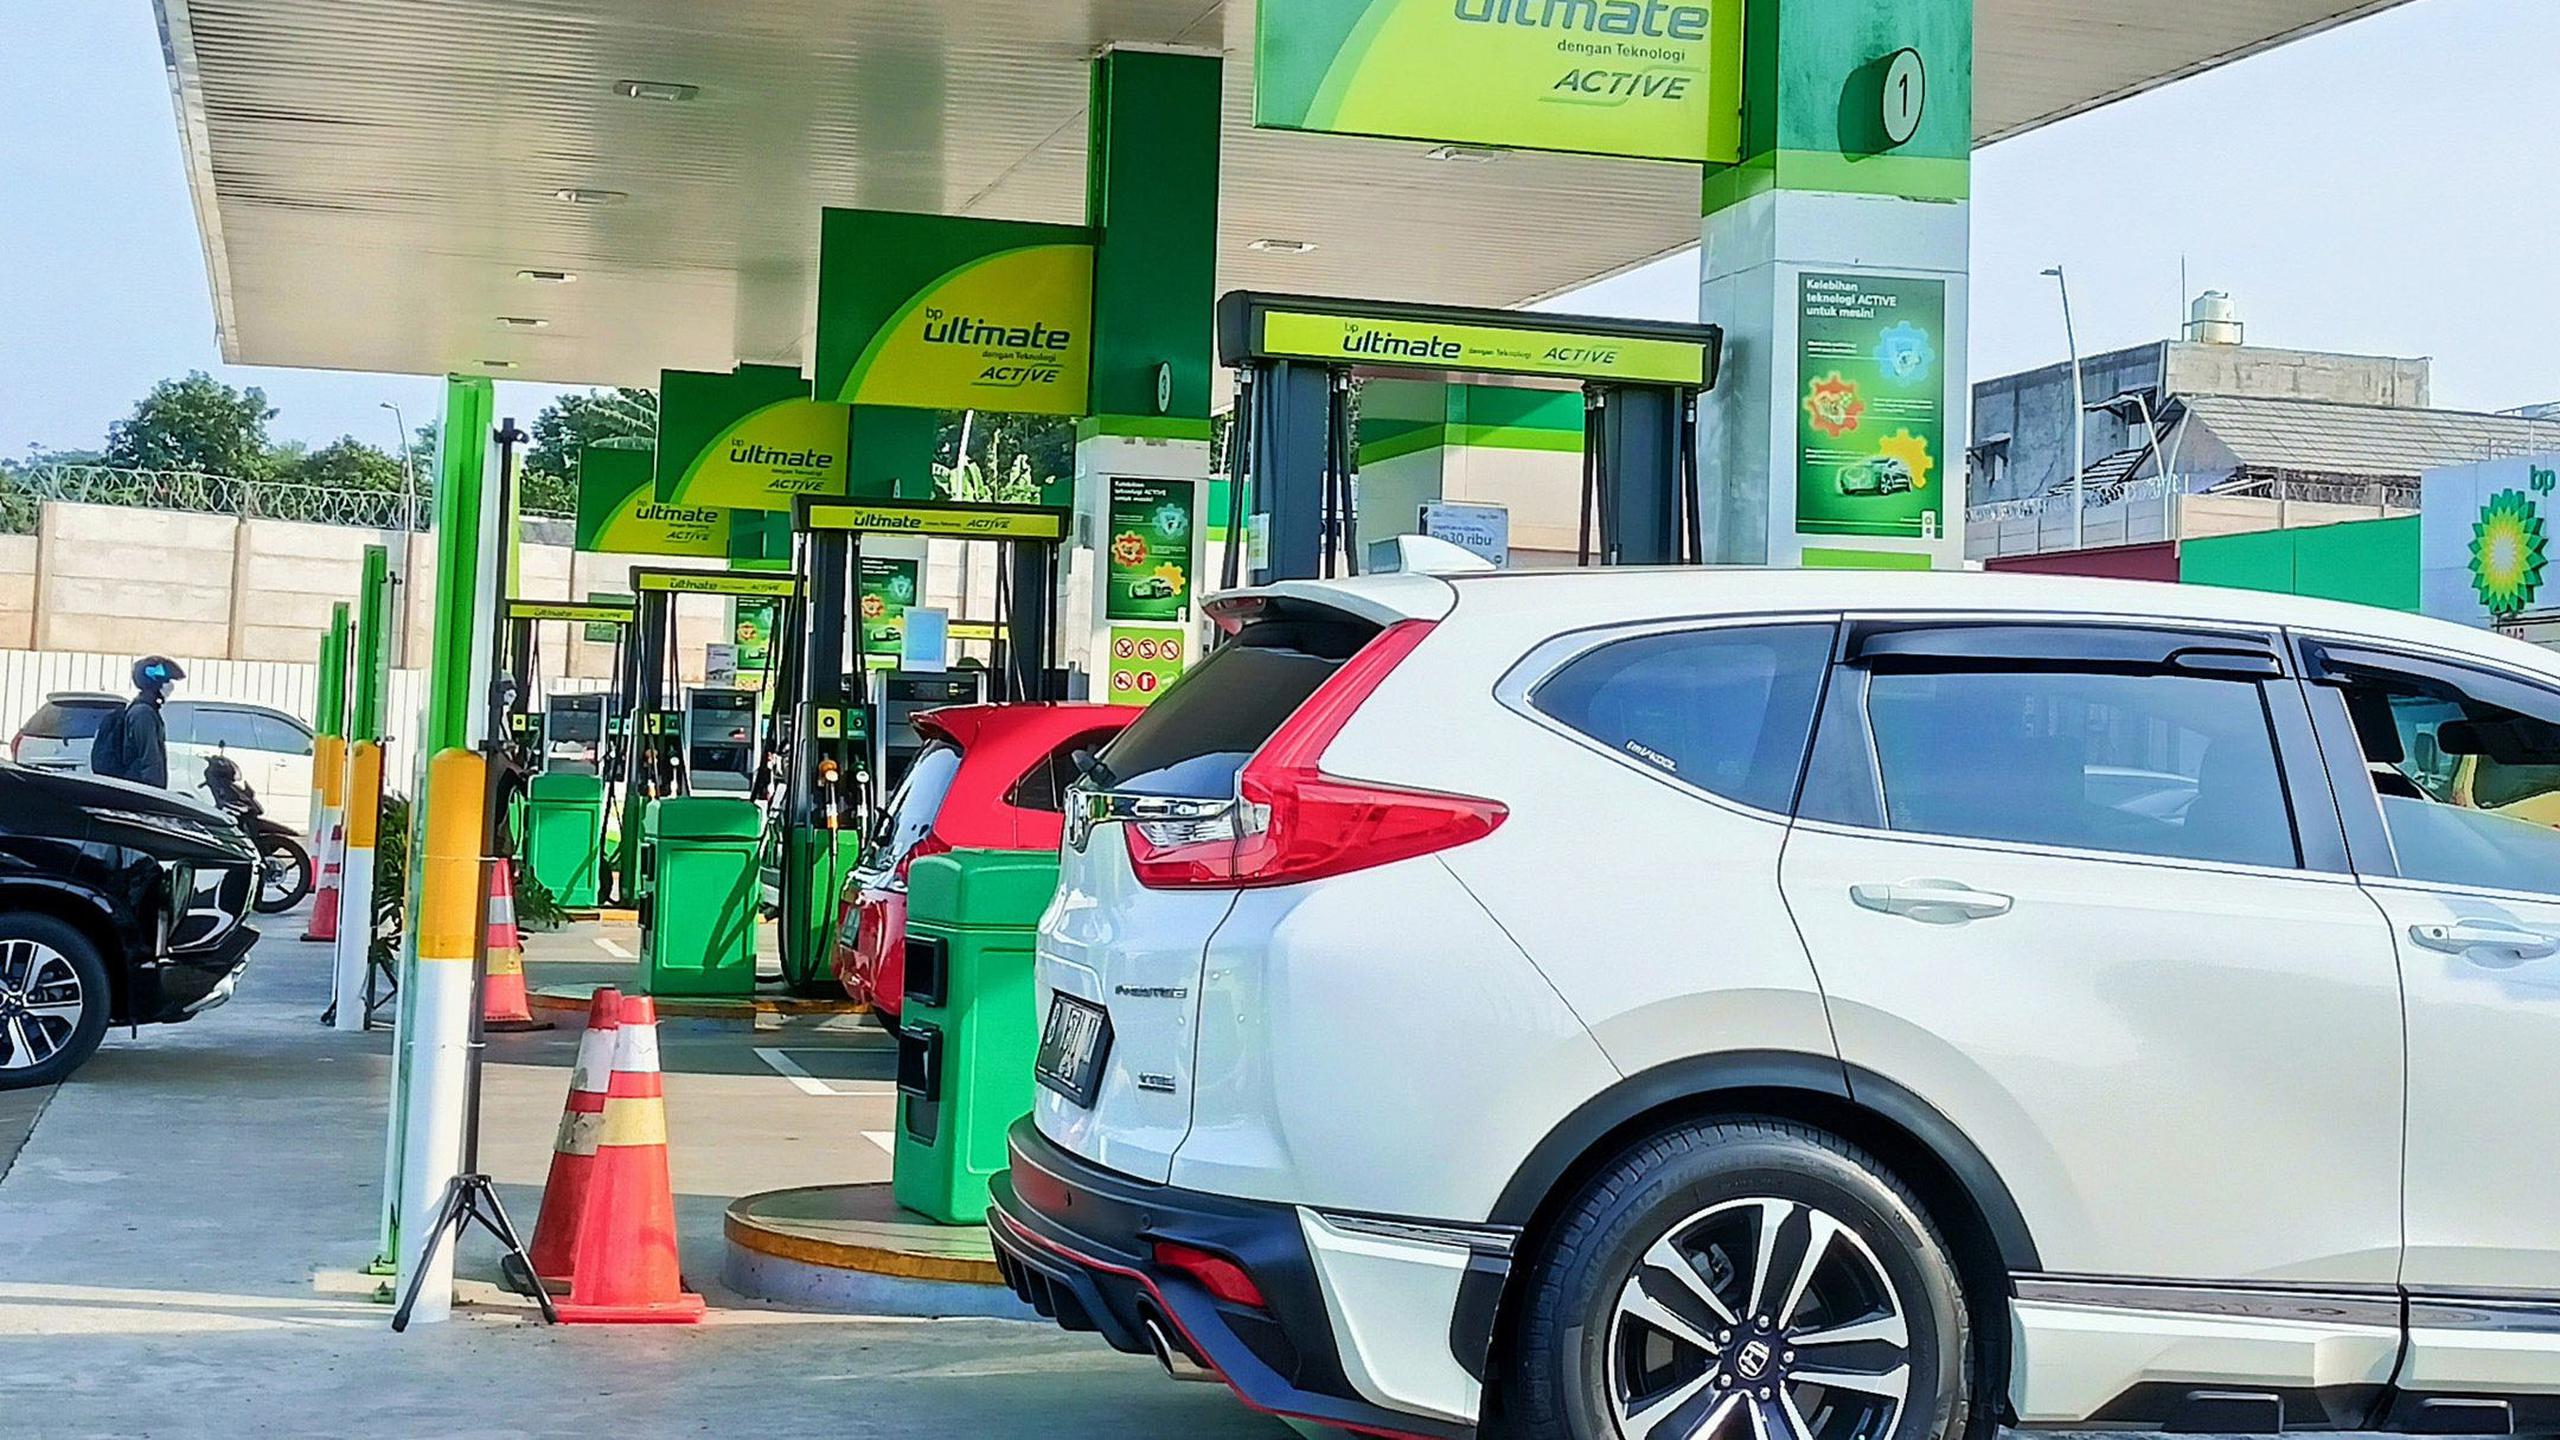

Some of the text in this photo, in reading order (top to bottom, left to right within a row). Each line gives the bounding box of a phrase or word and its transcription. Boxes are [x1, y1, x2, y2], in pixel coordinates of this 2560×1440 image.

[1557, 39, 1686, 62] dengan Teknologi
[1553, 69, 1691, 100] ACTIVE
[1899, 72, 1908, 117] 1
[1806, 279, 1858, 291] Kelebihan
[1806, 293, 1897, 307] teknologi ACTIVE
[925, 306, 943, 320] bp
[1806, 306, 1837, 316] untuk
[924, 316, 1070, 350] ultimate
[1343, 330, 1462, 358] ultimate
[1543, 347, 1617, 364] ACTIVE
[980, 366, 1059, 383] ACTIVE
[730, 444, 833, 468] ultimate
[768, 479, 825, 491] ACTIVE
[2530, 464, 2556, 497] bp
[636, 504, 718, 523] ultimate
[853, 513, 922, 529] ultimate
[1466, 532, 1492, 546] ribu
